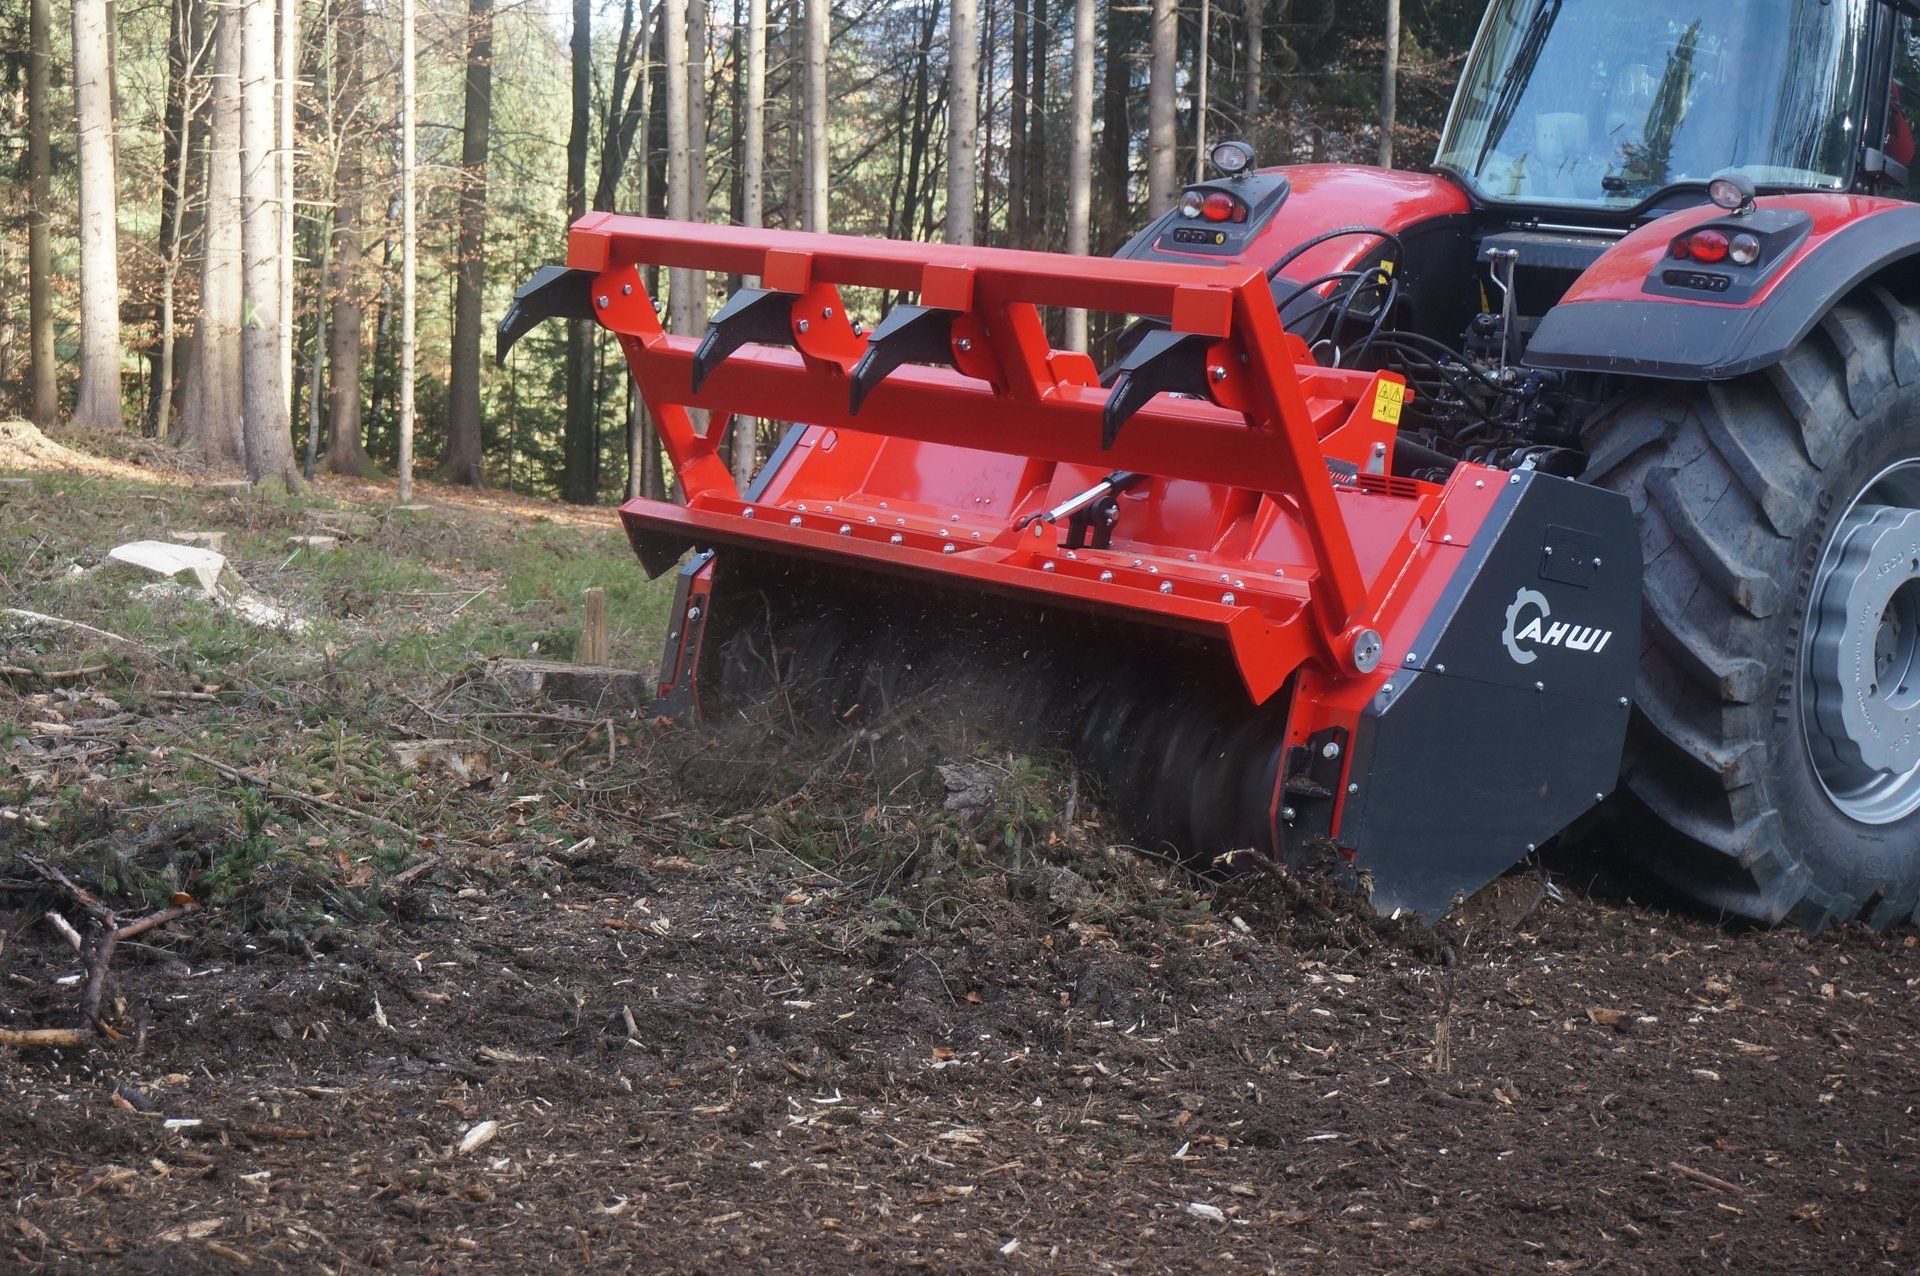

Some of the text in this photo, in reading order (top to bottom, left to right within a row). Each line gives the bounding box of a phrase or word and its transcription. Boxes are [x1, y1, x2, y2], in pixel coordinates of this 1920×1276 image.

[1876, 550, 1904, 580] AGCO
[1772, 488, 1834, 730] TRELLEBORG
[1515, 617, 1612, 653] AHWI
